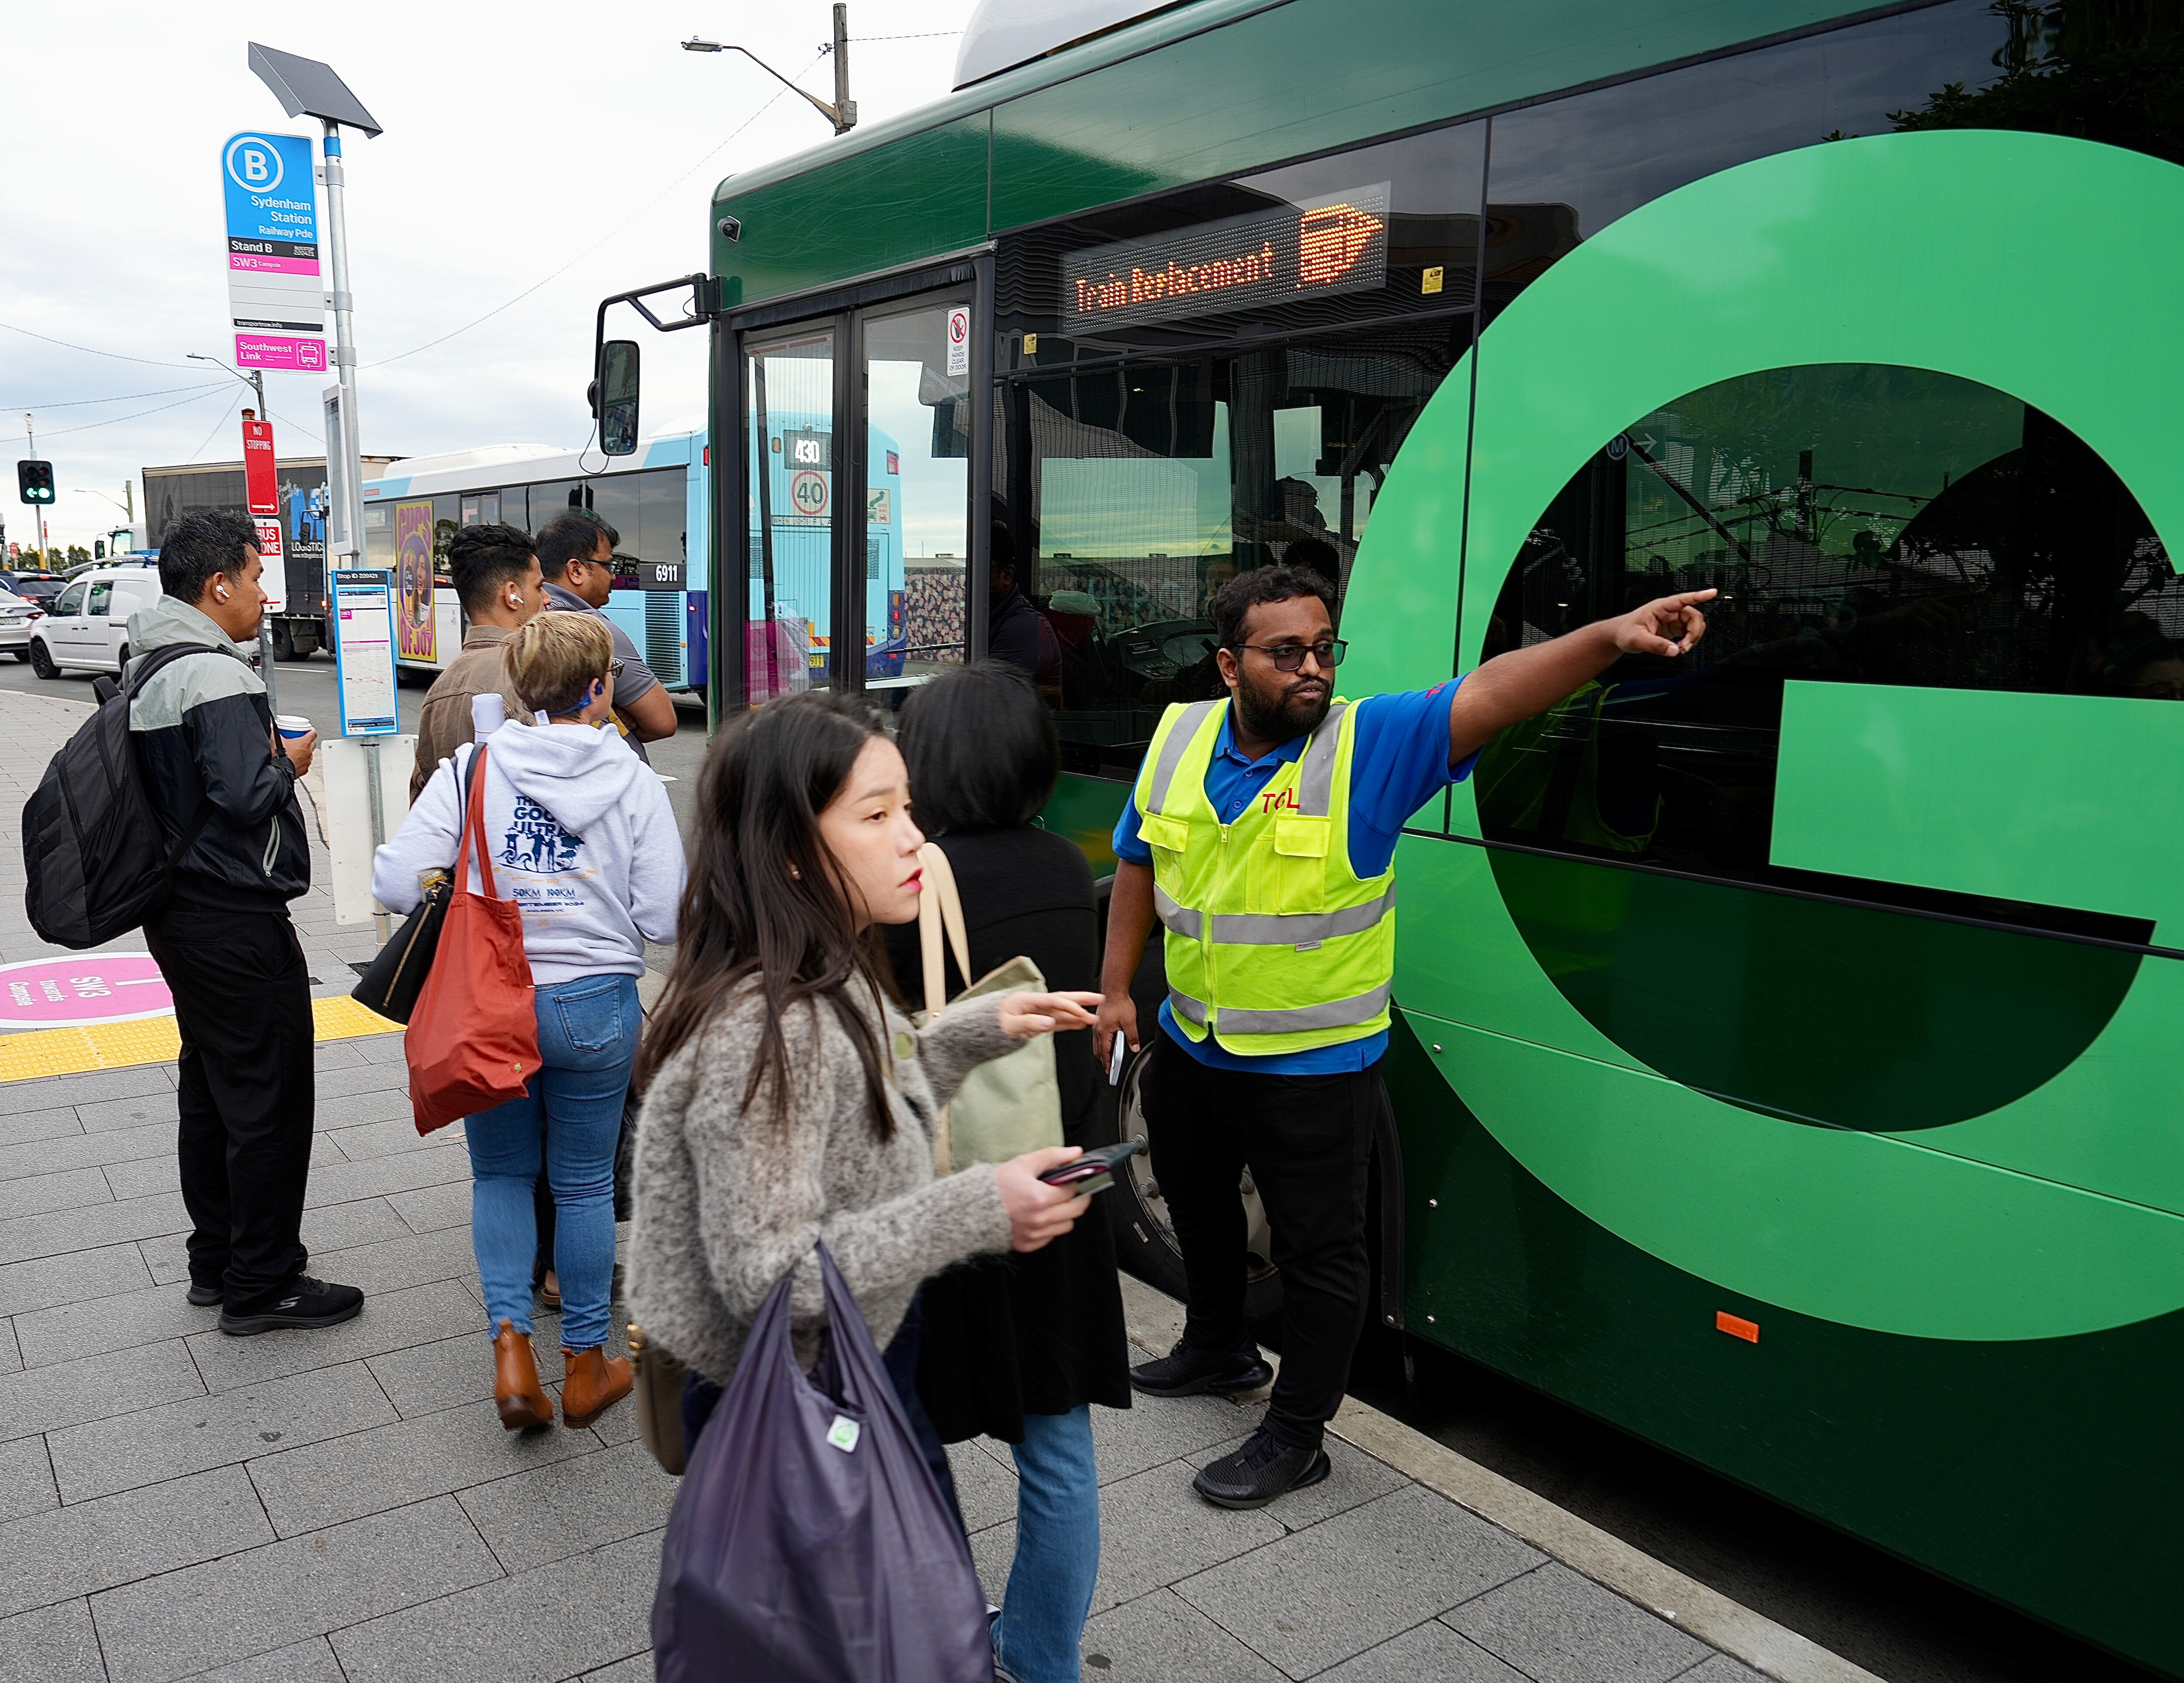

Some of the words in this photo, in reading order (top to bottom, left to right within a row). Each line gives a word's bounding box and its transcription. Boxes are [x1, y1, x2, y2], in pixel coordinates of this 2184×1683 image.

[244, 149, 269, 181] B
[250, 195, 312, 211] Sydenham
[270, 210, 312, 225] Station
[259, 225, 294, 239] Railway
[295, 228, 314, 239] Pde
[231, 240, 263, 252] Stand
[264, 243, 273, 253] B
[232, 256, 258, 268] SW3
[258, 260, 282, 269] Campsie
[1076, 272, 1126, 312] Train
[1132, 241, 1273, 302] Replacement
[239, 341, 293, 353] Southwest
[239, 351, 263, 361] Link
[252, 425, 263, 436] NO
[246, 439, 272, 450] STOPPING
[795, 439, 820, 463] 430
[797, 483, 823, 504] 40
[398, 506, 431, 551] CUPS
[260, 541, 280, 554] ONE
[656, 564, 678, 582] 6911
[512, 888, 541, 897] 50KM
[546, 888, 576, 897] 100KM
[7, 981, 38, 1007] Campsie
[38, 979, 70, 1002] towards
[69, 976, 112, 998] SW3
